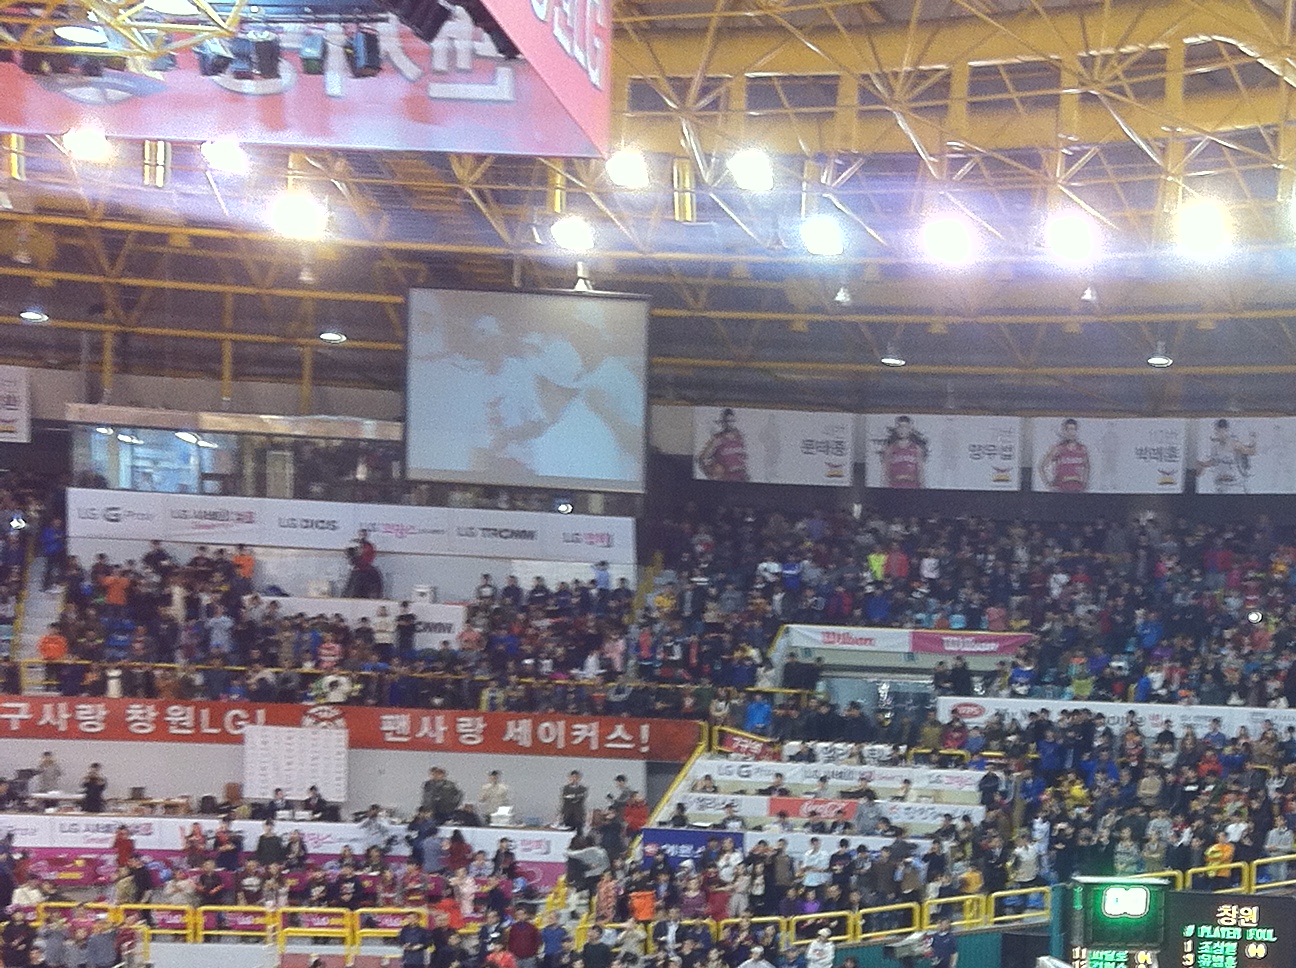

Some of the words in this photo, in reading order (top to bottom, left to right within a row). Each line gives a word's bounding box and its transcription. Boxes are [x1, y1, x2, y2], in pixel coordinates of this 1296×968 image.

[379, 713, 487, 746] 팬사랑
[502, 718, 651, 753] 세이커스!
[1215, 904, 1260, 926] 창원
[1246, 927, 1277, 942] FOUL
[1183, 939, 1193, 953] 1
[1182, 953, 1195, 966] 3
